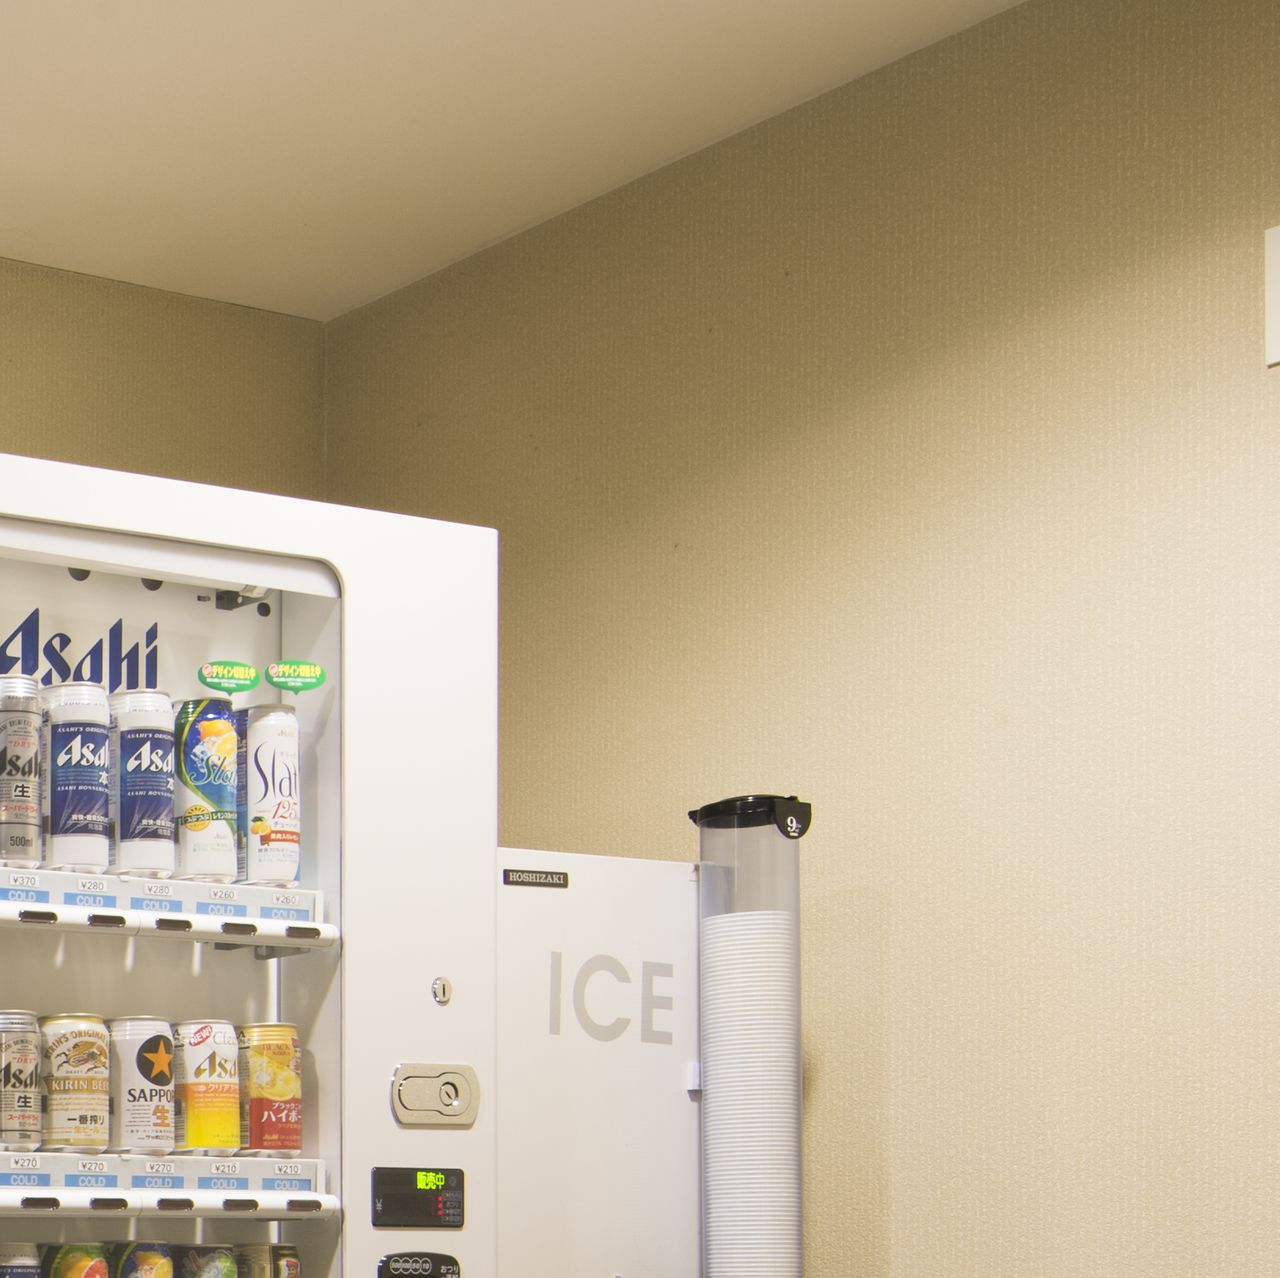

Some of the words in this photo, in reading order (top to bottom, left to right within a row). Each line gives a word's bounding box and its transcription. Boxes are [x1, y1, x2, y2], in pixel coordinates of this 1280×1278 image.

[13, 783, 31, 798] 生
[508, 872, 565, 884] HOSHIZAKI
[9, 890, 36, 902] COLD
[208, 904, 235, 916] COLD
[271, 908, 297, 920] COLD
[548, 951, 674, 1046] ICE
[51, 1079, 88, 1091] KIRIN
[17, 1095, 33, 1108] 生
[152, 1105, 170, 1128] 生
[10, 1174, 37, 1186] COLD
[211, 1178, 237, 1189] COLD
[416, 1171, 445, 1189] 販売中
